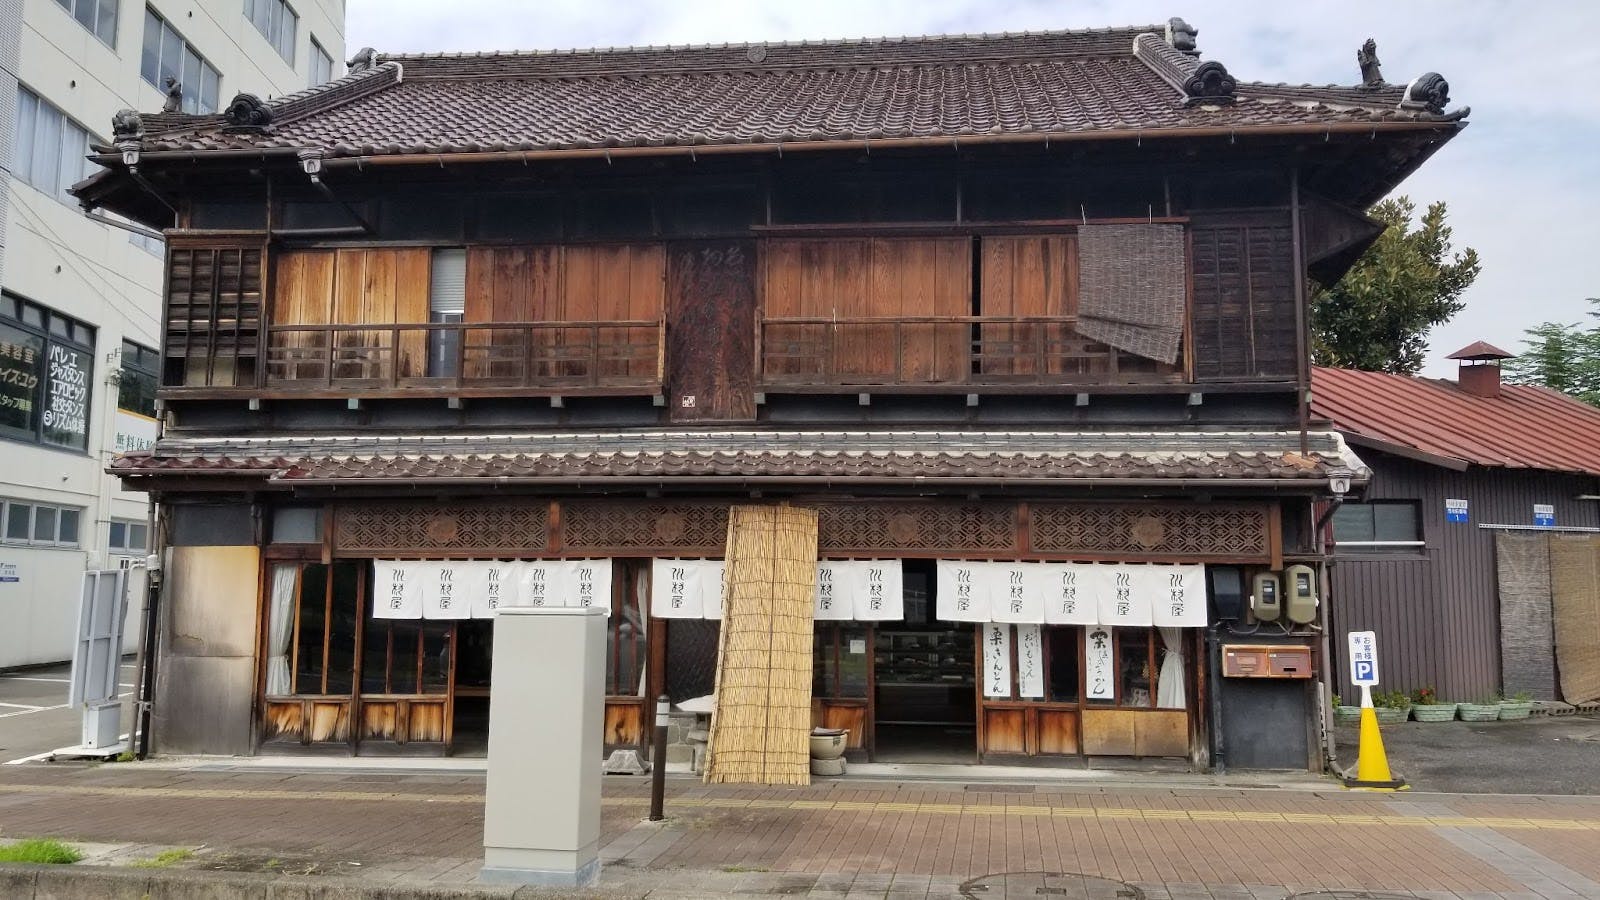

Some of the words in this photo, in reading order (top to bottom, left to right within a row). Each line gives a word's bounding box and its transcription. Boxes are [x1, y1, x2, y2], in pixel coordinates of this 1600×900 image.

[50, 362, 85, 386] ジャズダンス
[50, 379, 86, 401] エアロビック
[0, 393, 32, 412] タッフ募集
[51, 395, 85, 417] 社交ダンス
[1353, 636, 1363, 660] 専用
[1363, 637, 1372, 660] お客様
[1357, 662, 1371, 679] P
